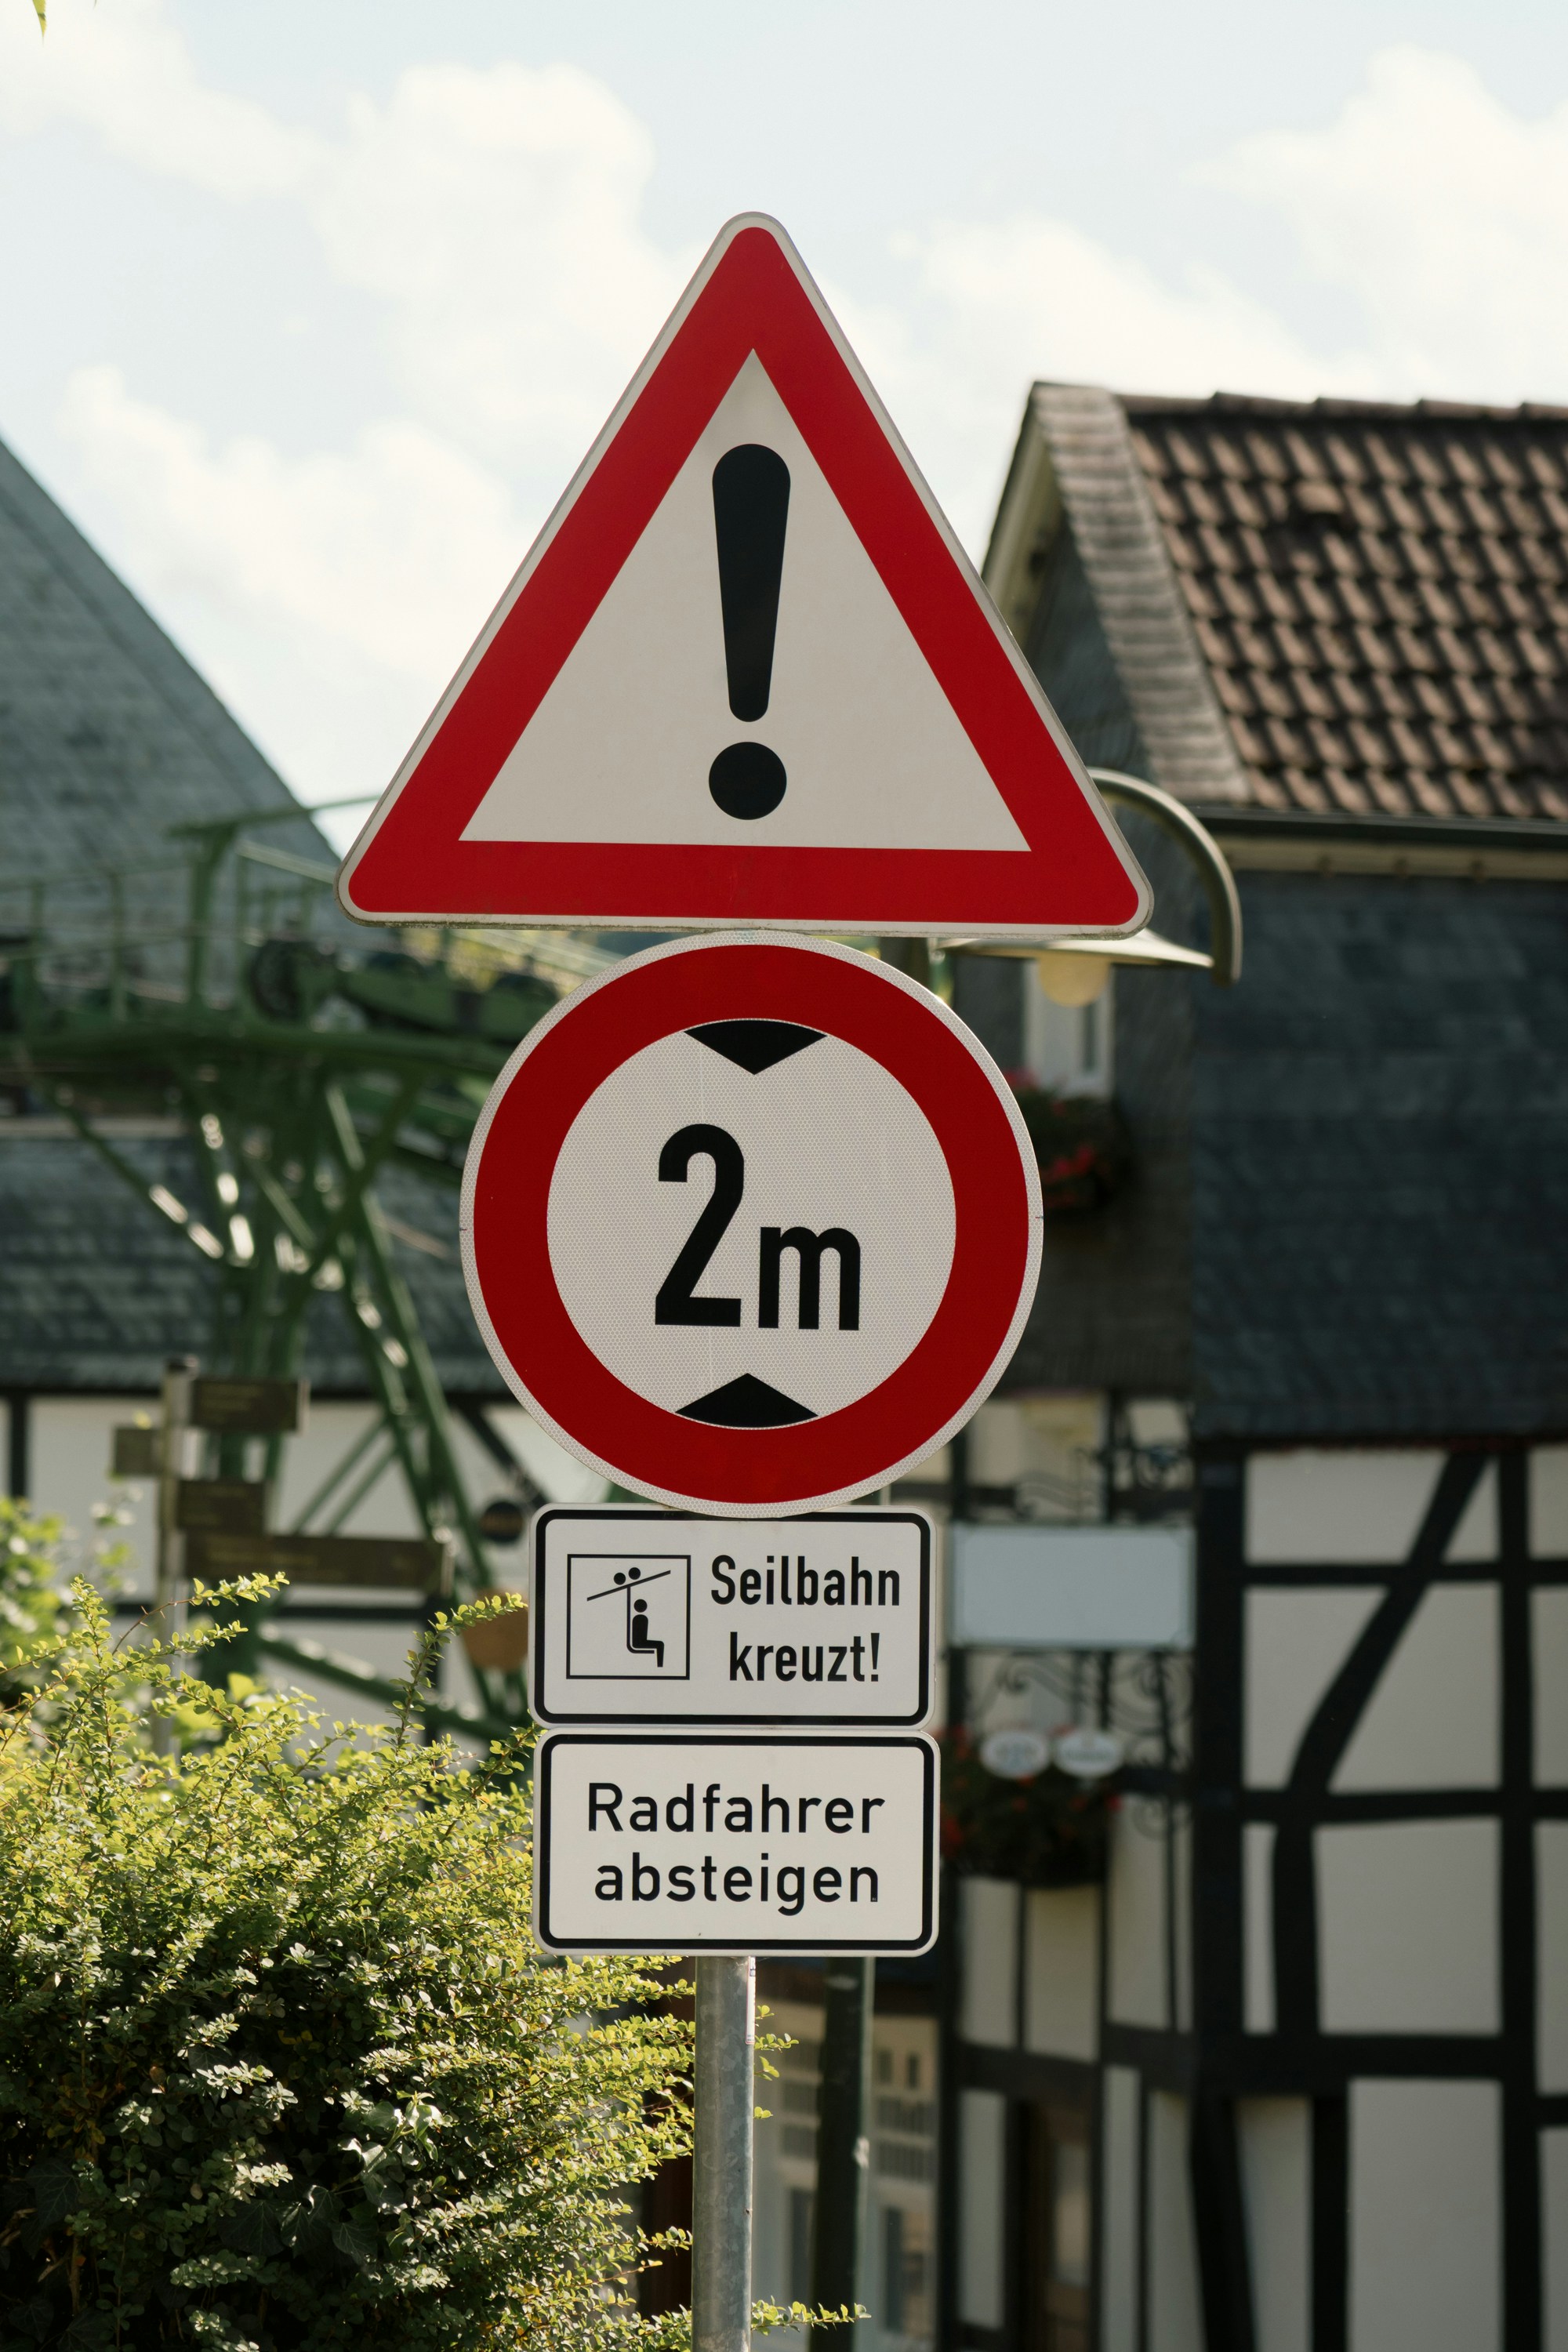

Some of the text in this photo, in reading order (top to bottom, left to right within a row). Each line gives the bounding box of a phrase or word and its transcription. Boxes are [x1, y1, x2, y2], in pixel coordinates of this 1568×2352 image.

[654, 1123, 862, 1331] 2m
[710, 1554, 901, 1606] Seilbahn
[729, 1631, 880, 1683] kreuzt!
[588, 1782, 886, 1834] Radfahrer
[594, 1852, 879, 1916] absteigen
